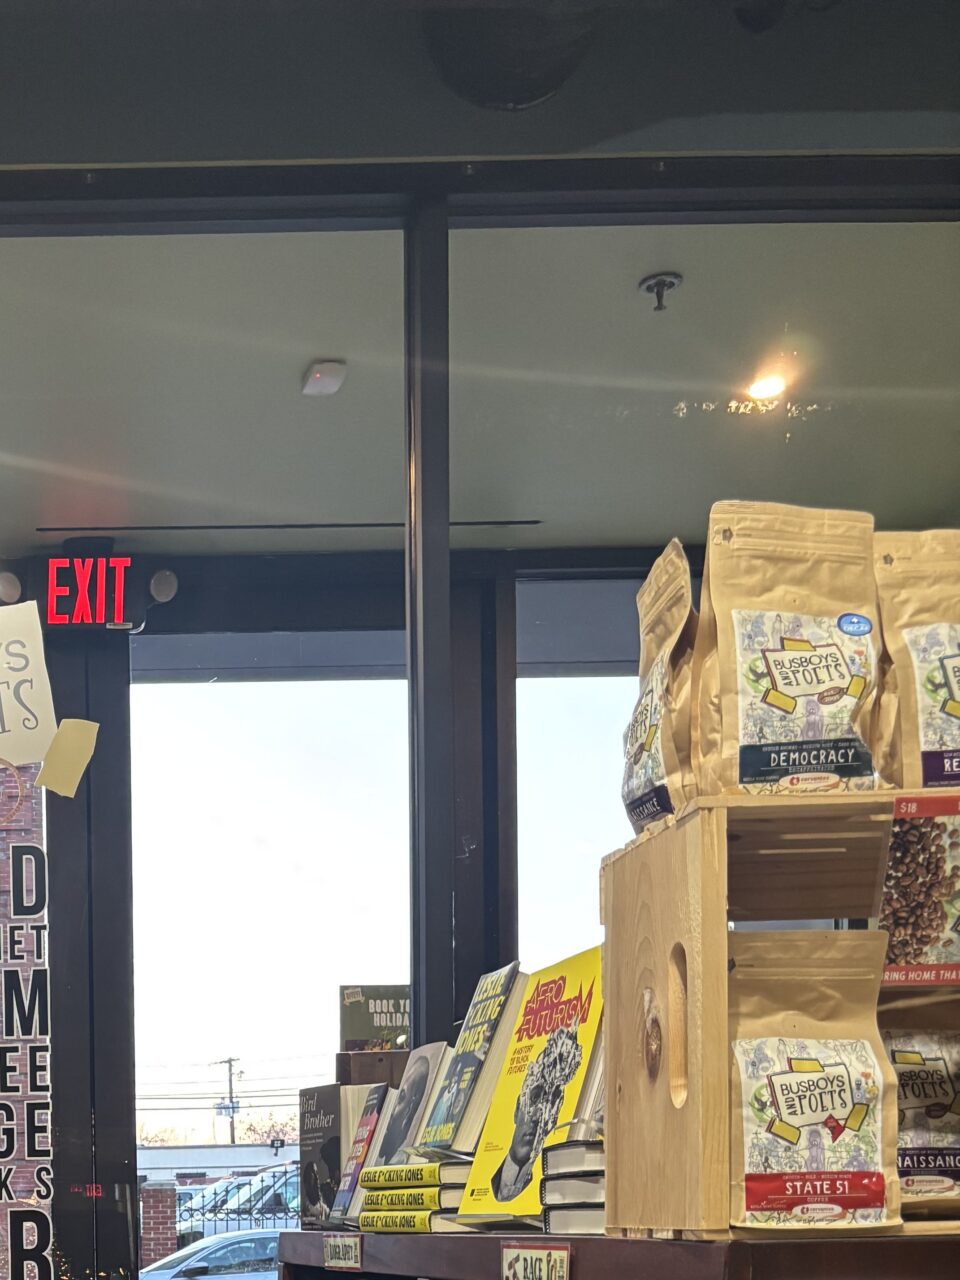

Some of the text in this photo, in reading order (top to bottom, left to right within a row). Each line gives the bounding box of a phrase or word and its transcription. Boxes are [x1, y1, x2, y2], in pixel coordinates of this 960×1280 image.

[47, 557, 131, 624] EXIT
[773, 652, 839, 671] BUSBOYS
[779, 670, 793, 687] AND
[791, 663, 846, 687] POETS
[770, 749, 855, 767] DEMOCRACY
[900, 802, 917, 814] $18
[882, 970, 906, 982] RING
[908, 971, 936, 981] HOME
[368, 999, 395, 1013] BOOK
[516, 979, 594, 1043] FUTURISM
[374, 1013, 410, 1026] HOLIDA
[780, 1074, 845, 1096] BUSBOYS
[901, 1080, 949, 1099] POETS
[786, 1096, 798, 1116] AND
[796, 1088, 848, 1115] POETS
[304, 1110, 335, 1130] Brother
[360, 1171, 377, 1183] LESLIE
[404, 1168, 424, 1183] JONES
[786, 1181, 849, 1195] STATE 51
[365, 1193, 380, 1206] LESLIE
[405, 1192, 425, 1206] JONES
[360, 1215, 376, 1228] LESLIE
[398, 1214, 416, 1228] JONES
